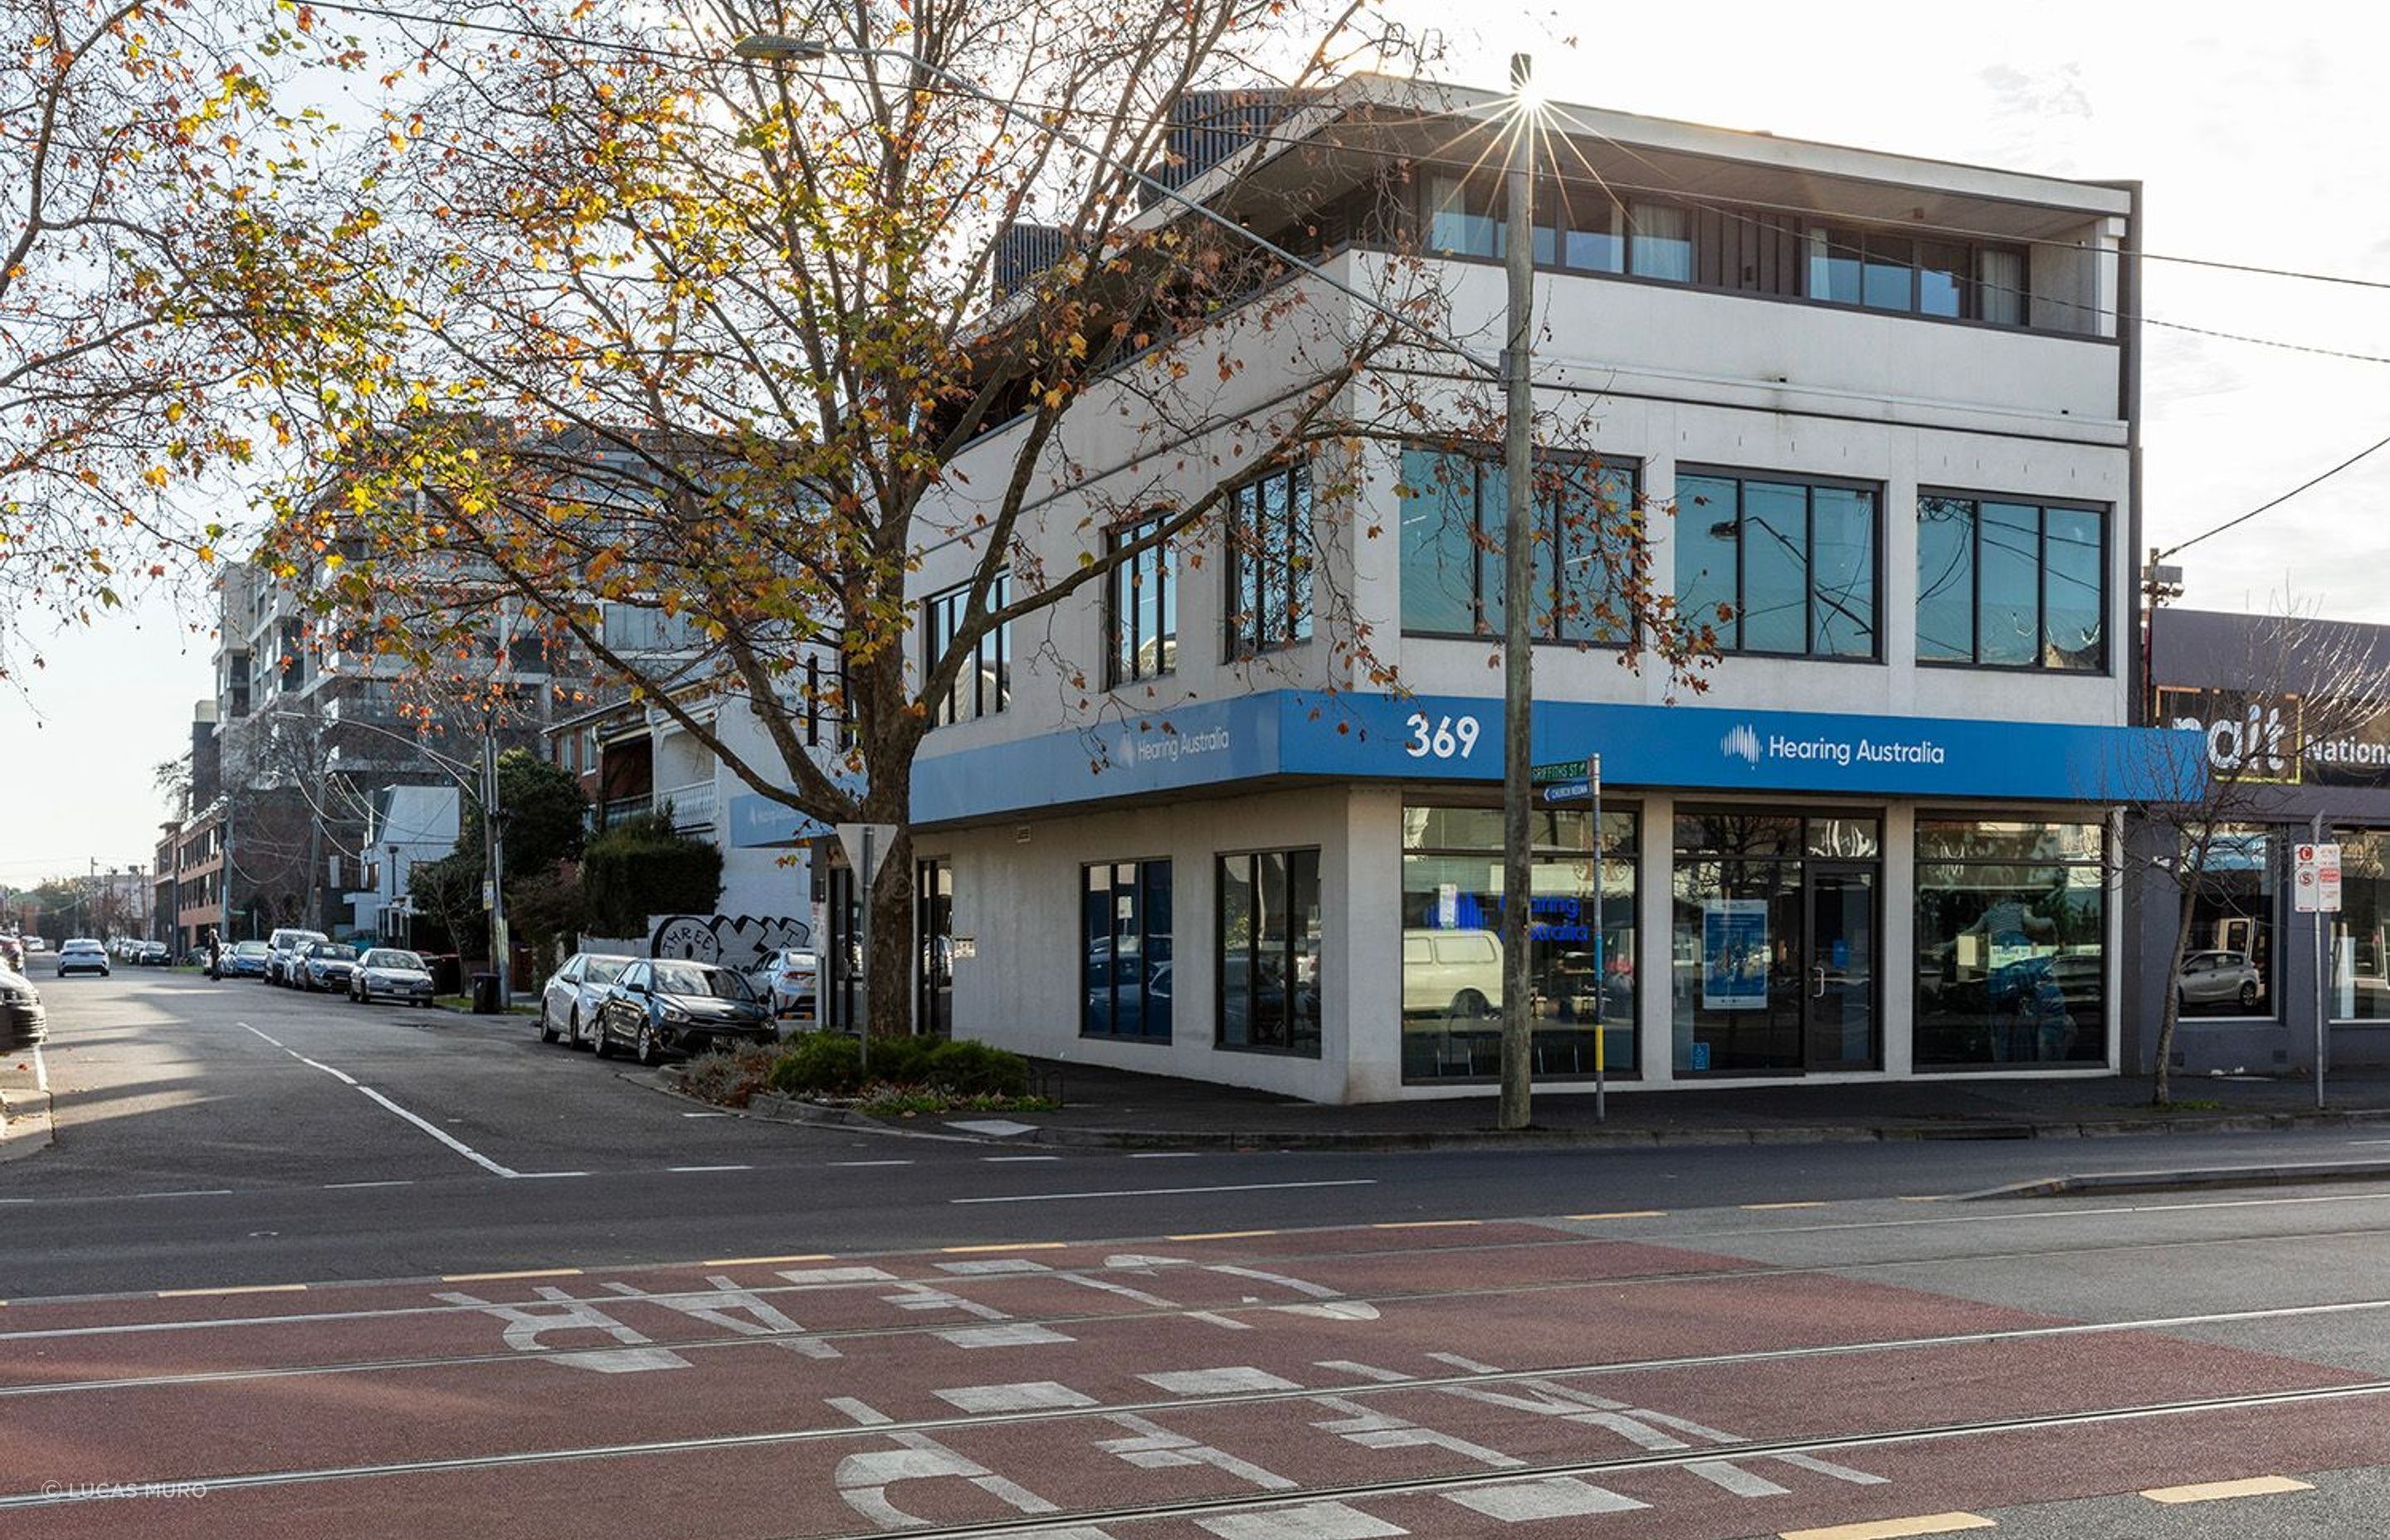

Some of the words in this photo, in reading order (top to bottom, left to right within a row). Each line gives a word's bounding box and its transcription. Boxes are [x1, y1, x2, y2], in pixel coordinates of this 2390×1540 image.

[1138, 736, 1178, 762] Hearing
[1180, 725, 1230, 755] Australia
[1406, 714, 1480, 759] 369
[1769, 734, 1851, 766] Hearing
[1856, 737, 1944, 764] Australia
[2172, 704, 2285, 771] ait
[1500, 894, 1580, 918] aring
[662, 927, 714, 951] THREE
[1498, 920, 1588, 942] stralia
[430, 1254, 1381, 1374] CLEAR
[827, 1352, 1890, 1540] KEEP
